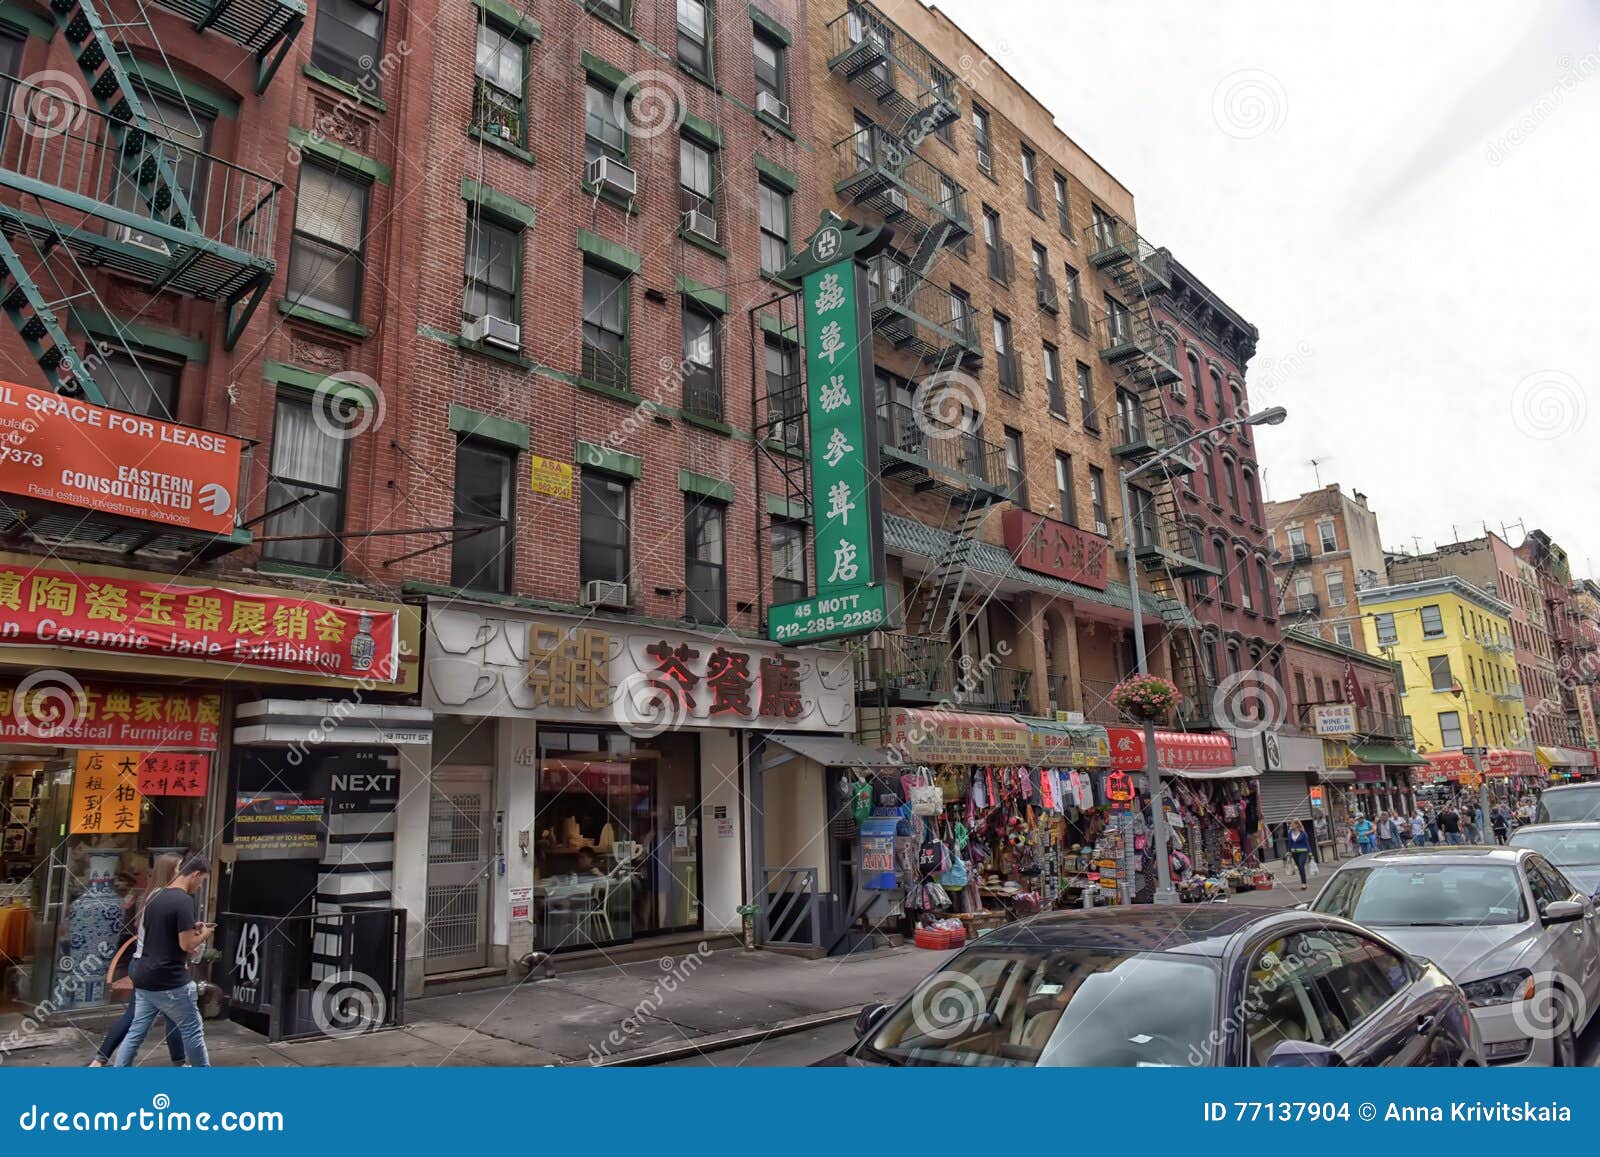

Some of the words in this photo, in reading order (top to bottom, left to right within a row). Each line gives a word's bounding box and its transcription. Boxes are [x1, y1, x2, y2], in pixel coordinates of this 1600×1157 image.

[25, 393, 103, 427] SPACE
[108, 413, 155, 438] FOR
[160, 425, 228, 454] LEASE
[61, 469, 193, 510] CONSOLIDATED
[117, 465, 194, 494] EASTERN
[28, 484, 54, 497] Real
[150, 510, 191, 525] services
[794, 604, 812, 618] 45
[818, 594, 860, 614] MOTT
[776, 608, 882, 639] 212-285-2288
[37, 618, 150, 650] Ceramic
[161, 632, 222, 656] Jade
[232, 638, 342, 669] Exhibition
[529, 623, 610, 660] CHA
[528, 653, 610, 686] CHAN
[645, 640, 803, 719] 茶餐廳
[528, 680, 610, 709] TANG
[38, 721, 112, 739] Classical
[120, 724, 193, 741] Furniture
[330, 773, 397, 792] NEXT
[338, 802, 356, 810] KTV
[861, 853, 894, 870] ATM
[236, 922, 260, 981] 43
[232, 985, 257, 1005] MOTT
